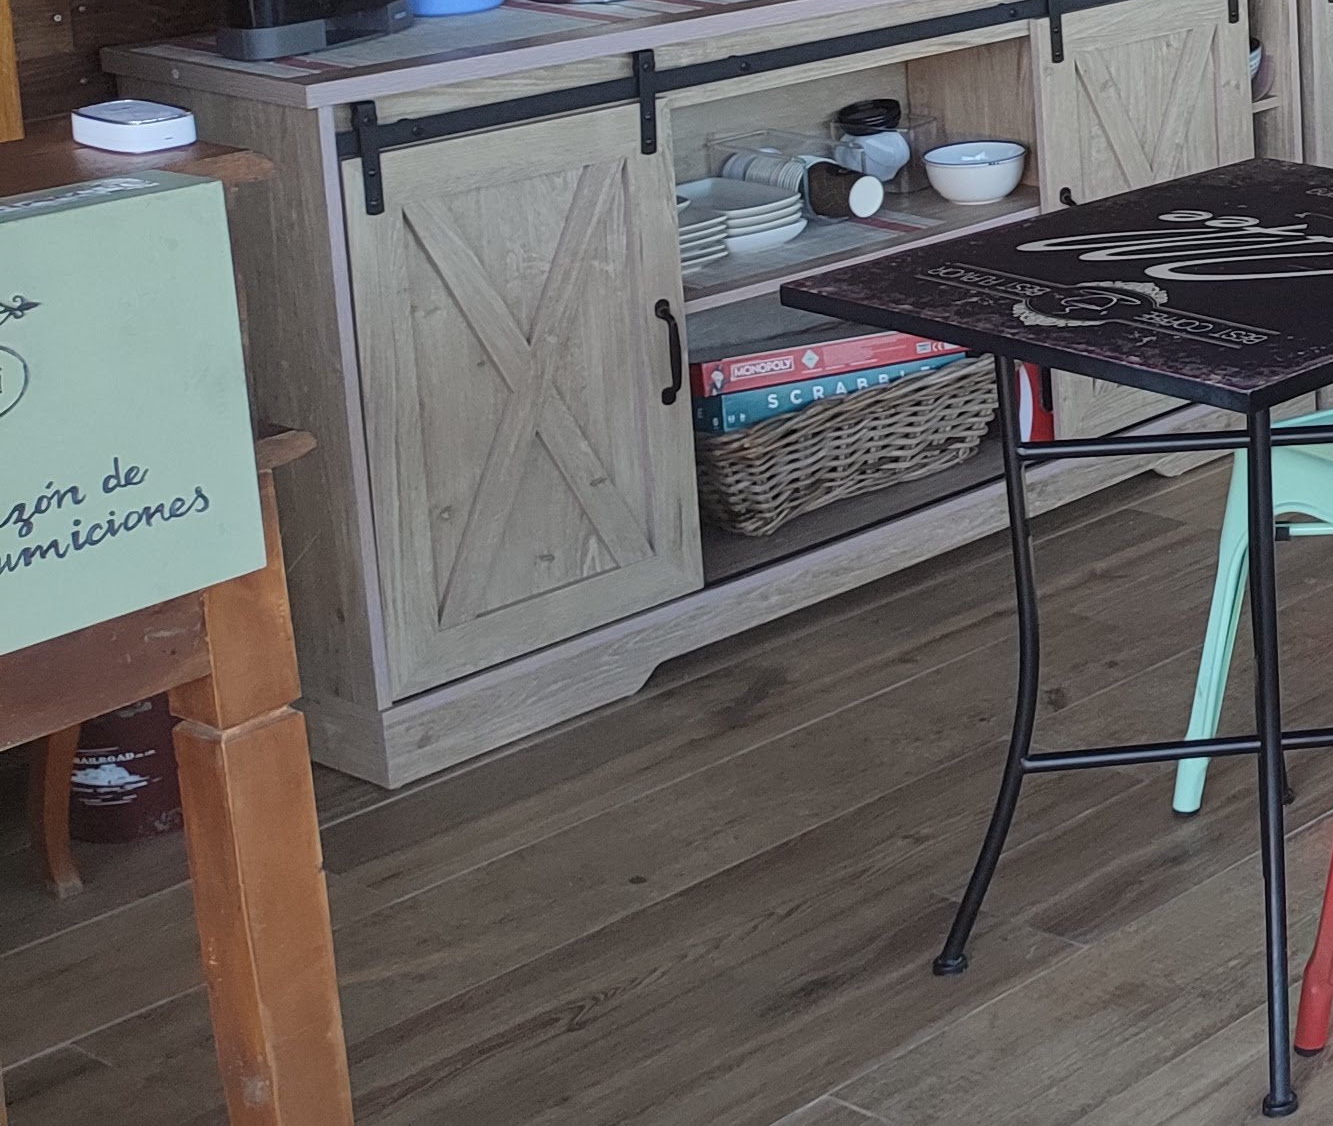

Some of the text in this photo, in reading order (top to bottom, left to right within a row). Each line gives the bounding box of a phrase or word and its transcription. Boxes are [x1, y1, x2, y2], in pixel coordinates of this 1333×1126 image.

[1208, 326, 1269, 345] BEST
[733, 358, 792, 379] MONOPOLY
[767, 365, 930, 409] SCRABB
[0, 456, 150, 538] zón de
